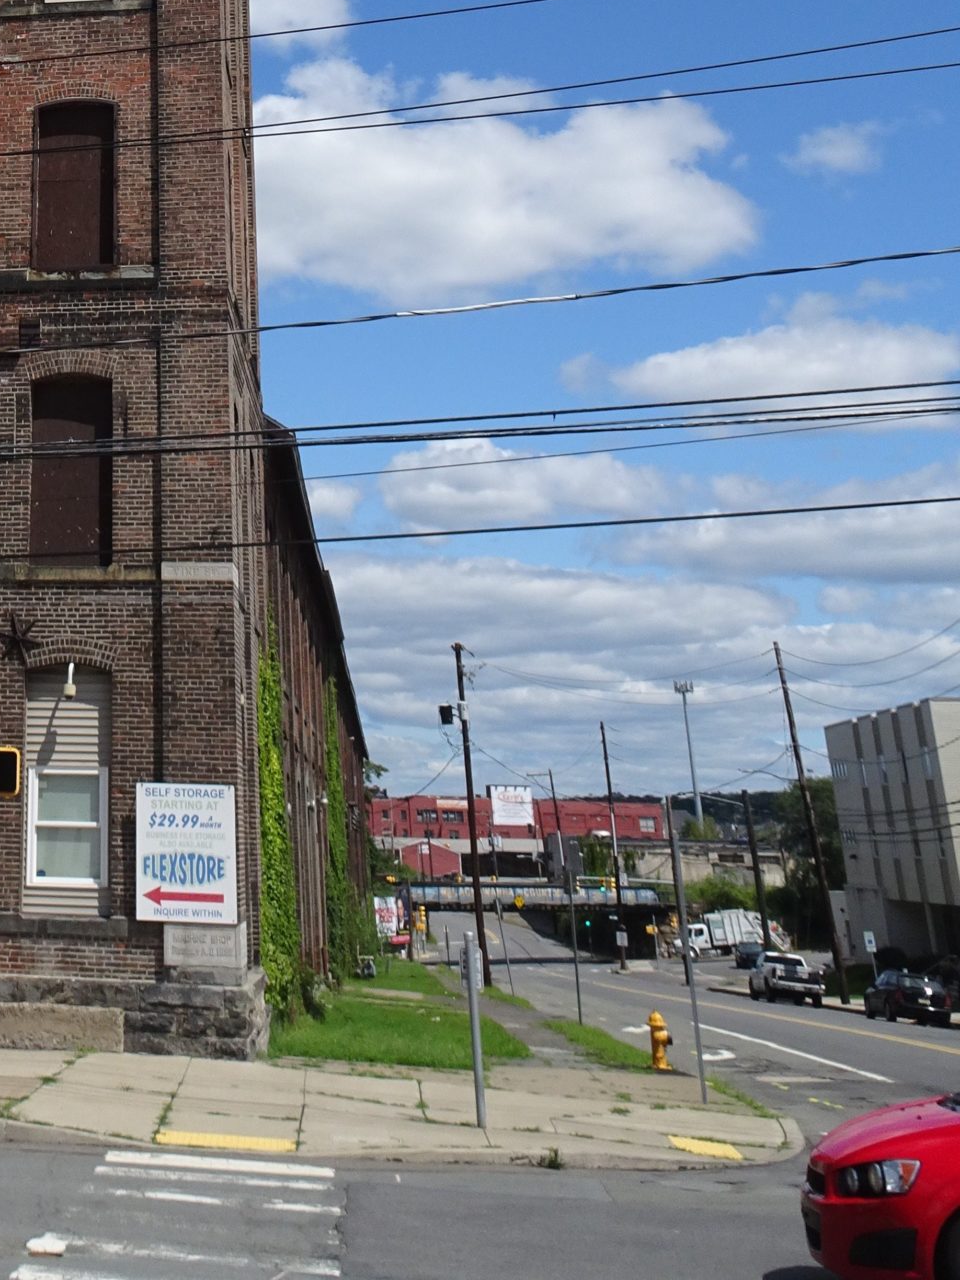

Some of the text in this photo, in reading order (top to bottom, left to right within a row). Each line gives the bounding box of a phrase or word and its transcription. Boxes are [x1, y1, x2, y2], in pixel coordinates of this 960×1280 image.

[144, 787, 225, 799] SELF STORAGE
[150, 799, 220, 811] STARTING AT
[148, 811, 200, 829] $29.99
[195, 832, 226, 841] STORAGE
[178, 841, 213, 849] AVAILABLE
[143, 851, 225, 886] FLEXSTORE
[153, 907, 223, 920] INQUIRE WITHIN
